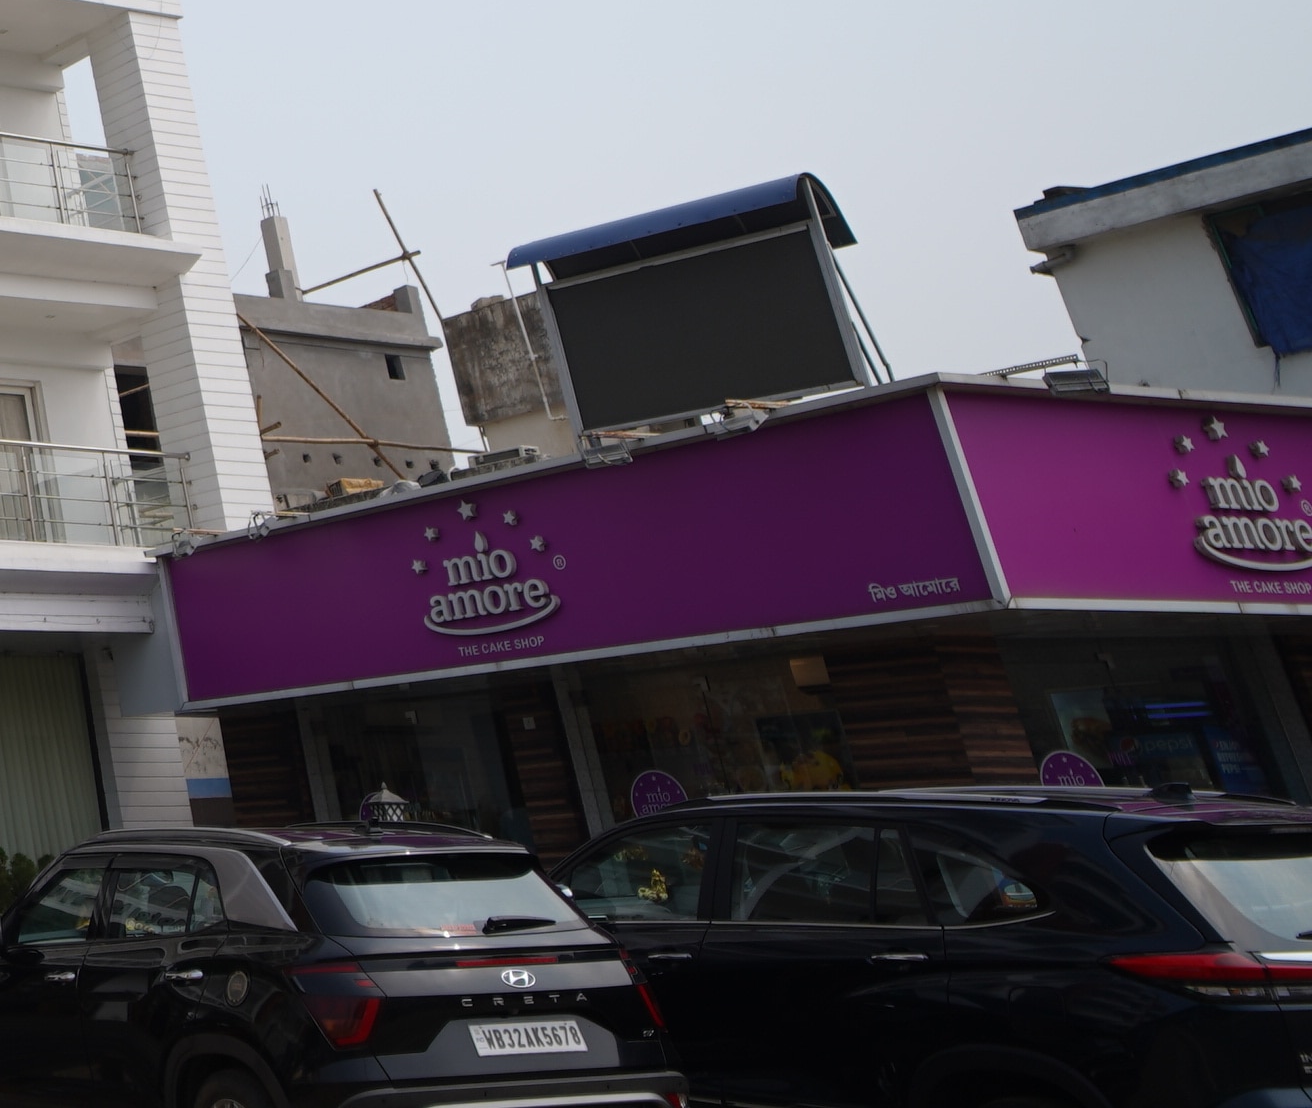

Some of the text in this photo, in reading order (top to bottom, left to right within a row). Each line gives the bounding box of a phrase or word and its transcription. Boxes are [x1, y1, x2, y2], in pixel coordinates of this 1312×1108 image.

[1200, 455, 1280, 513] mio
[1196, 515, 1312, 553] amore
[443, 534, 517, 586] mio
[868, 578, 961, 603] মিও আমোরে
[1230, 580, 1311, 594] THE CAKE SHOP
[429, 578, 550, 624] amore
[458, 636, 545, 658] THE CAKE SHOP
[1057, 769, 1086, 786] mio
[645, 787, 671, 803] mio
[461, 992, 588, 1007] CRETA
[481, 1025, 582, 1050] WB32AK5678
